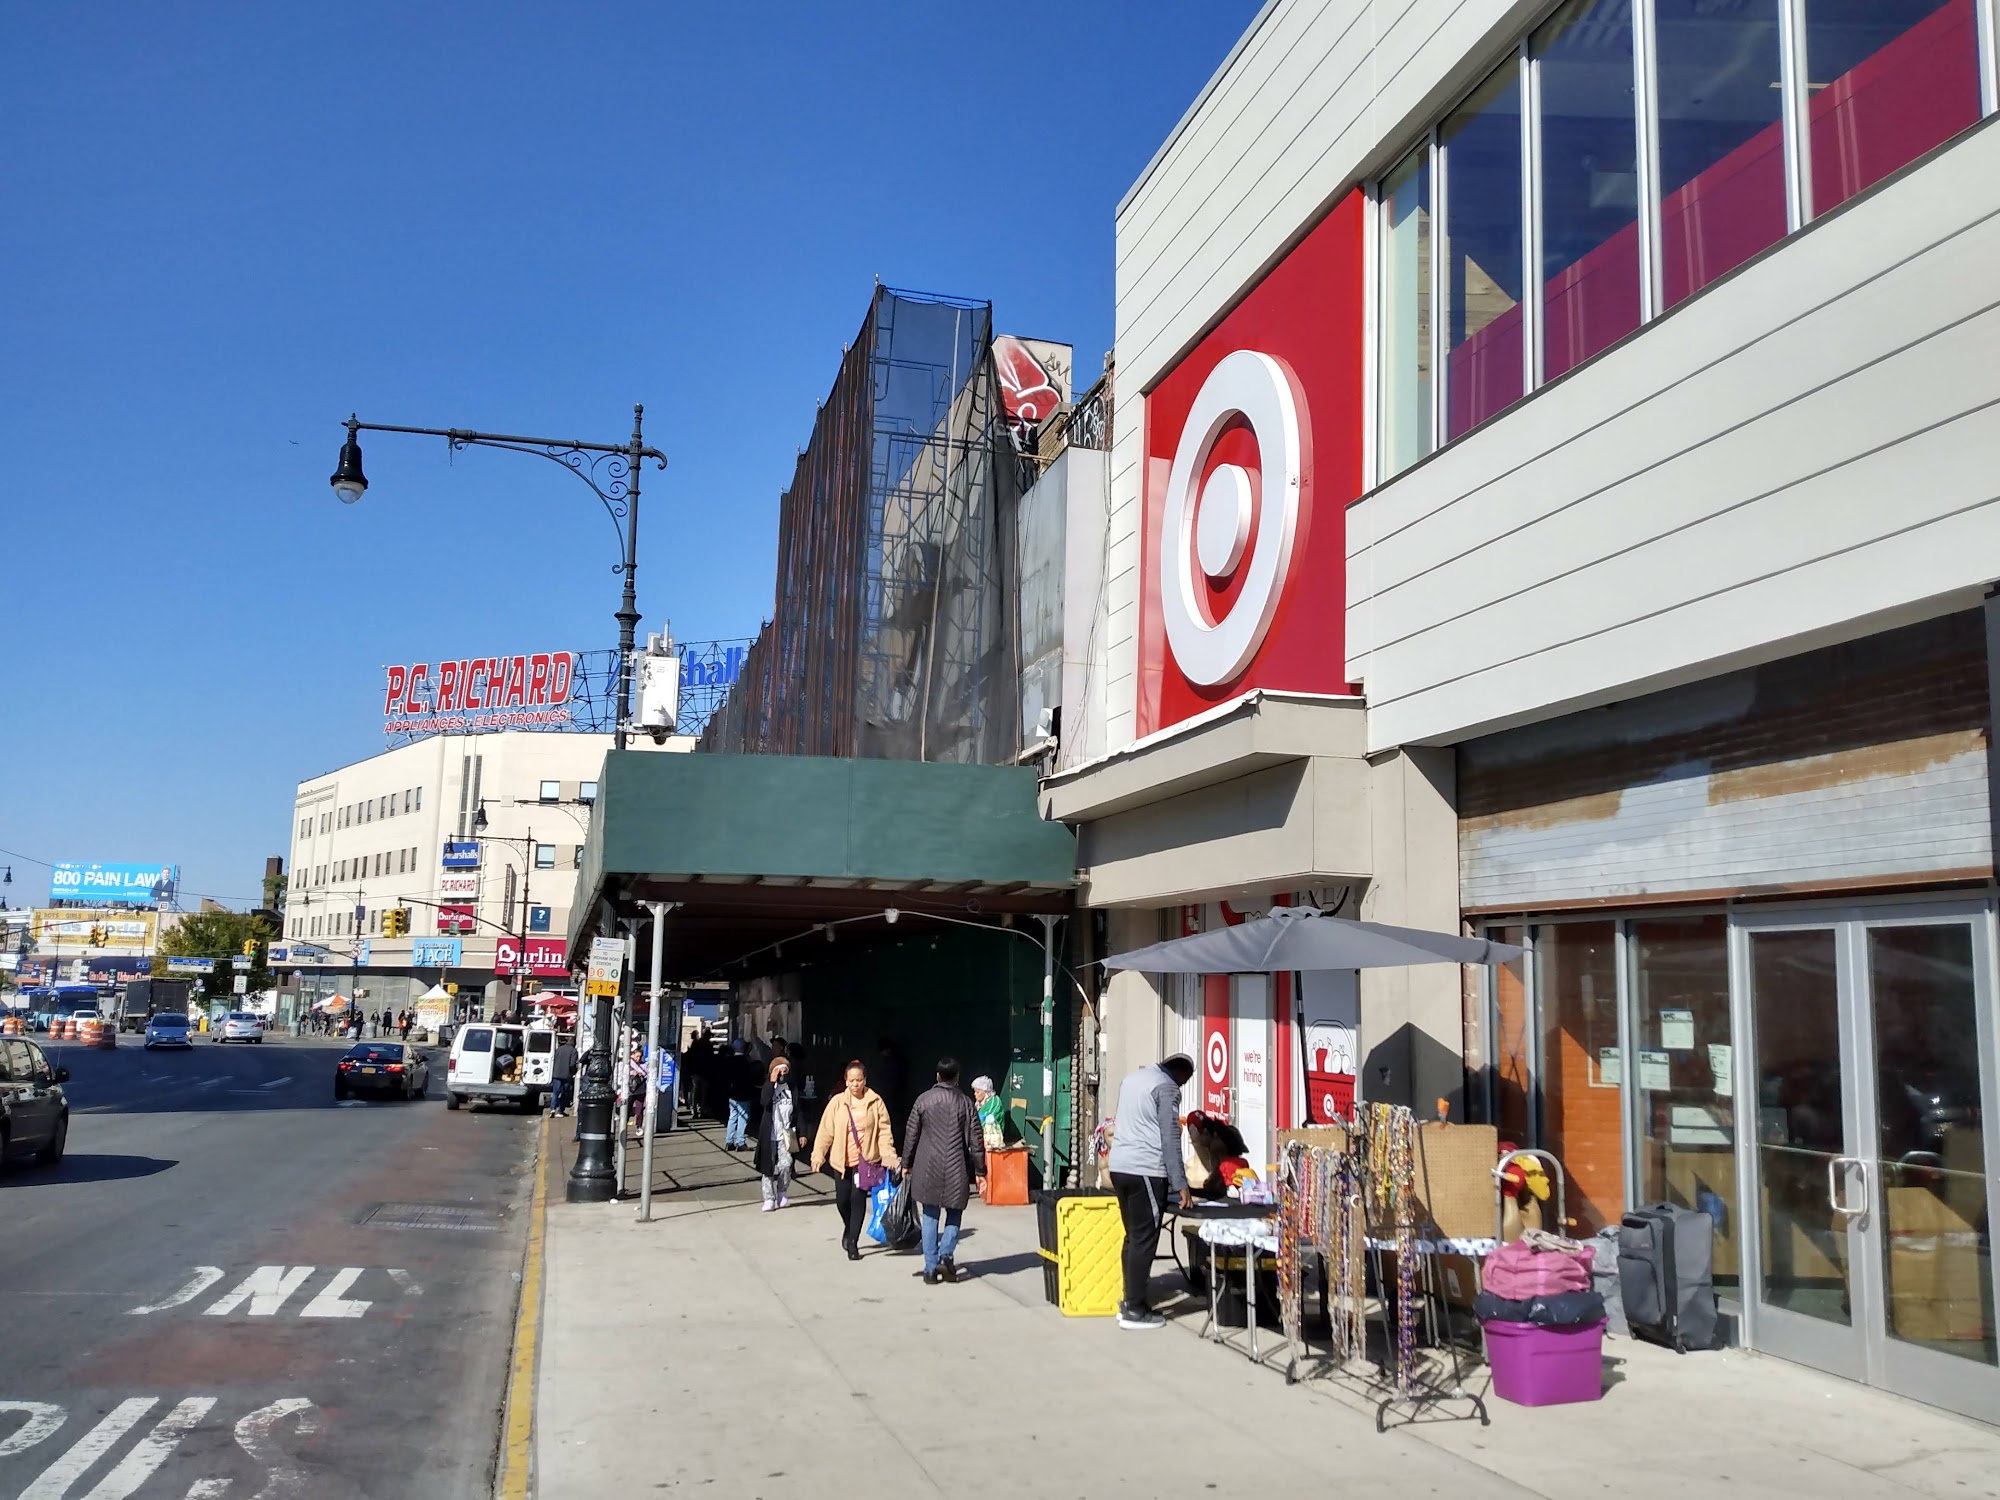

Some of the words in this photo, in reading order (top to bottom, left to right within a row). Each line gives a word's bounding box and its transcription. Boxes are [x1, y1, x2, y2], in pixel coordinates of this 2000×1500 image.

[383, 663, 429, 716] P.C.
[436, 651, 573, 712] RICHARD
[383, 716, 465, 734] APPLIANCES
[474, 709, 568, 728] ELECTRONICS
[53, 871, 81, 886] 800
[83, 872, 121, 887] PAIN
[123, 873, 161, 888] LAW
[450, 879, 476, 892] RICHARD
[415, 948, 454, 962] PLACE
[498, 944, 566, 963] Burlin
[1243, 1049, 1262, 1064] we're
[1243, 1068, 1263, 1087] hiring
[1208, 1090, 1226, 1108] targt
